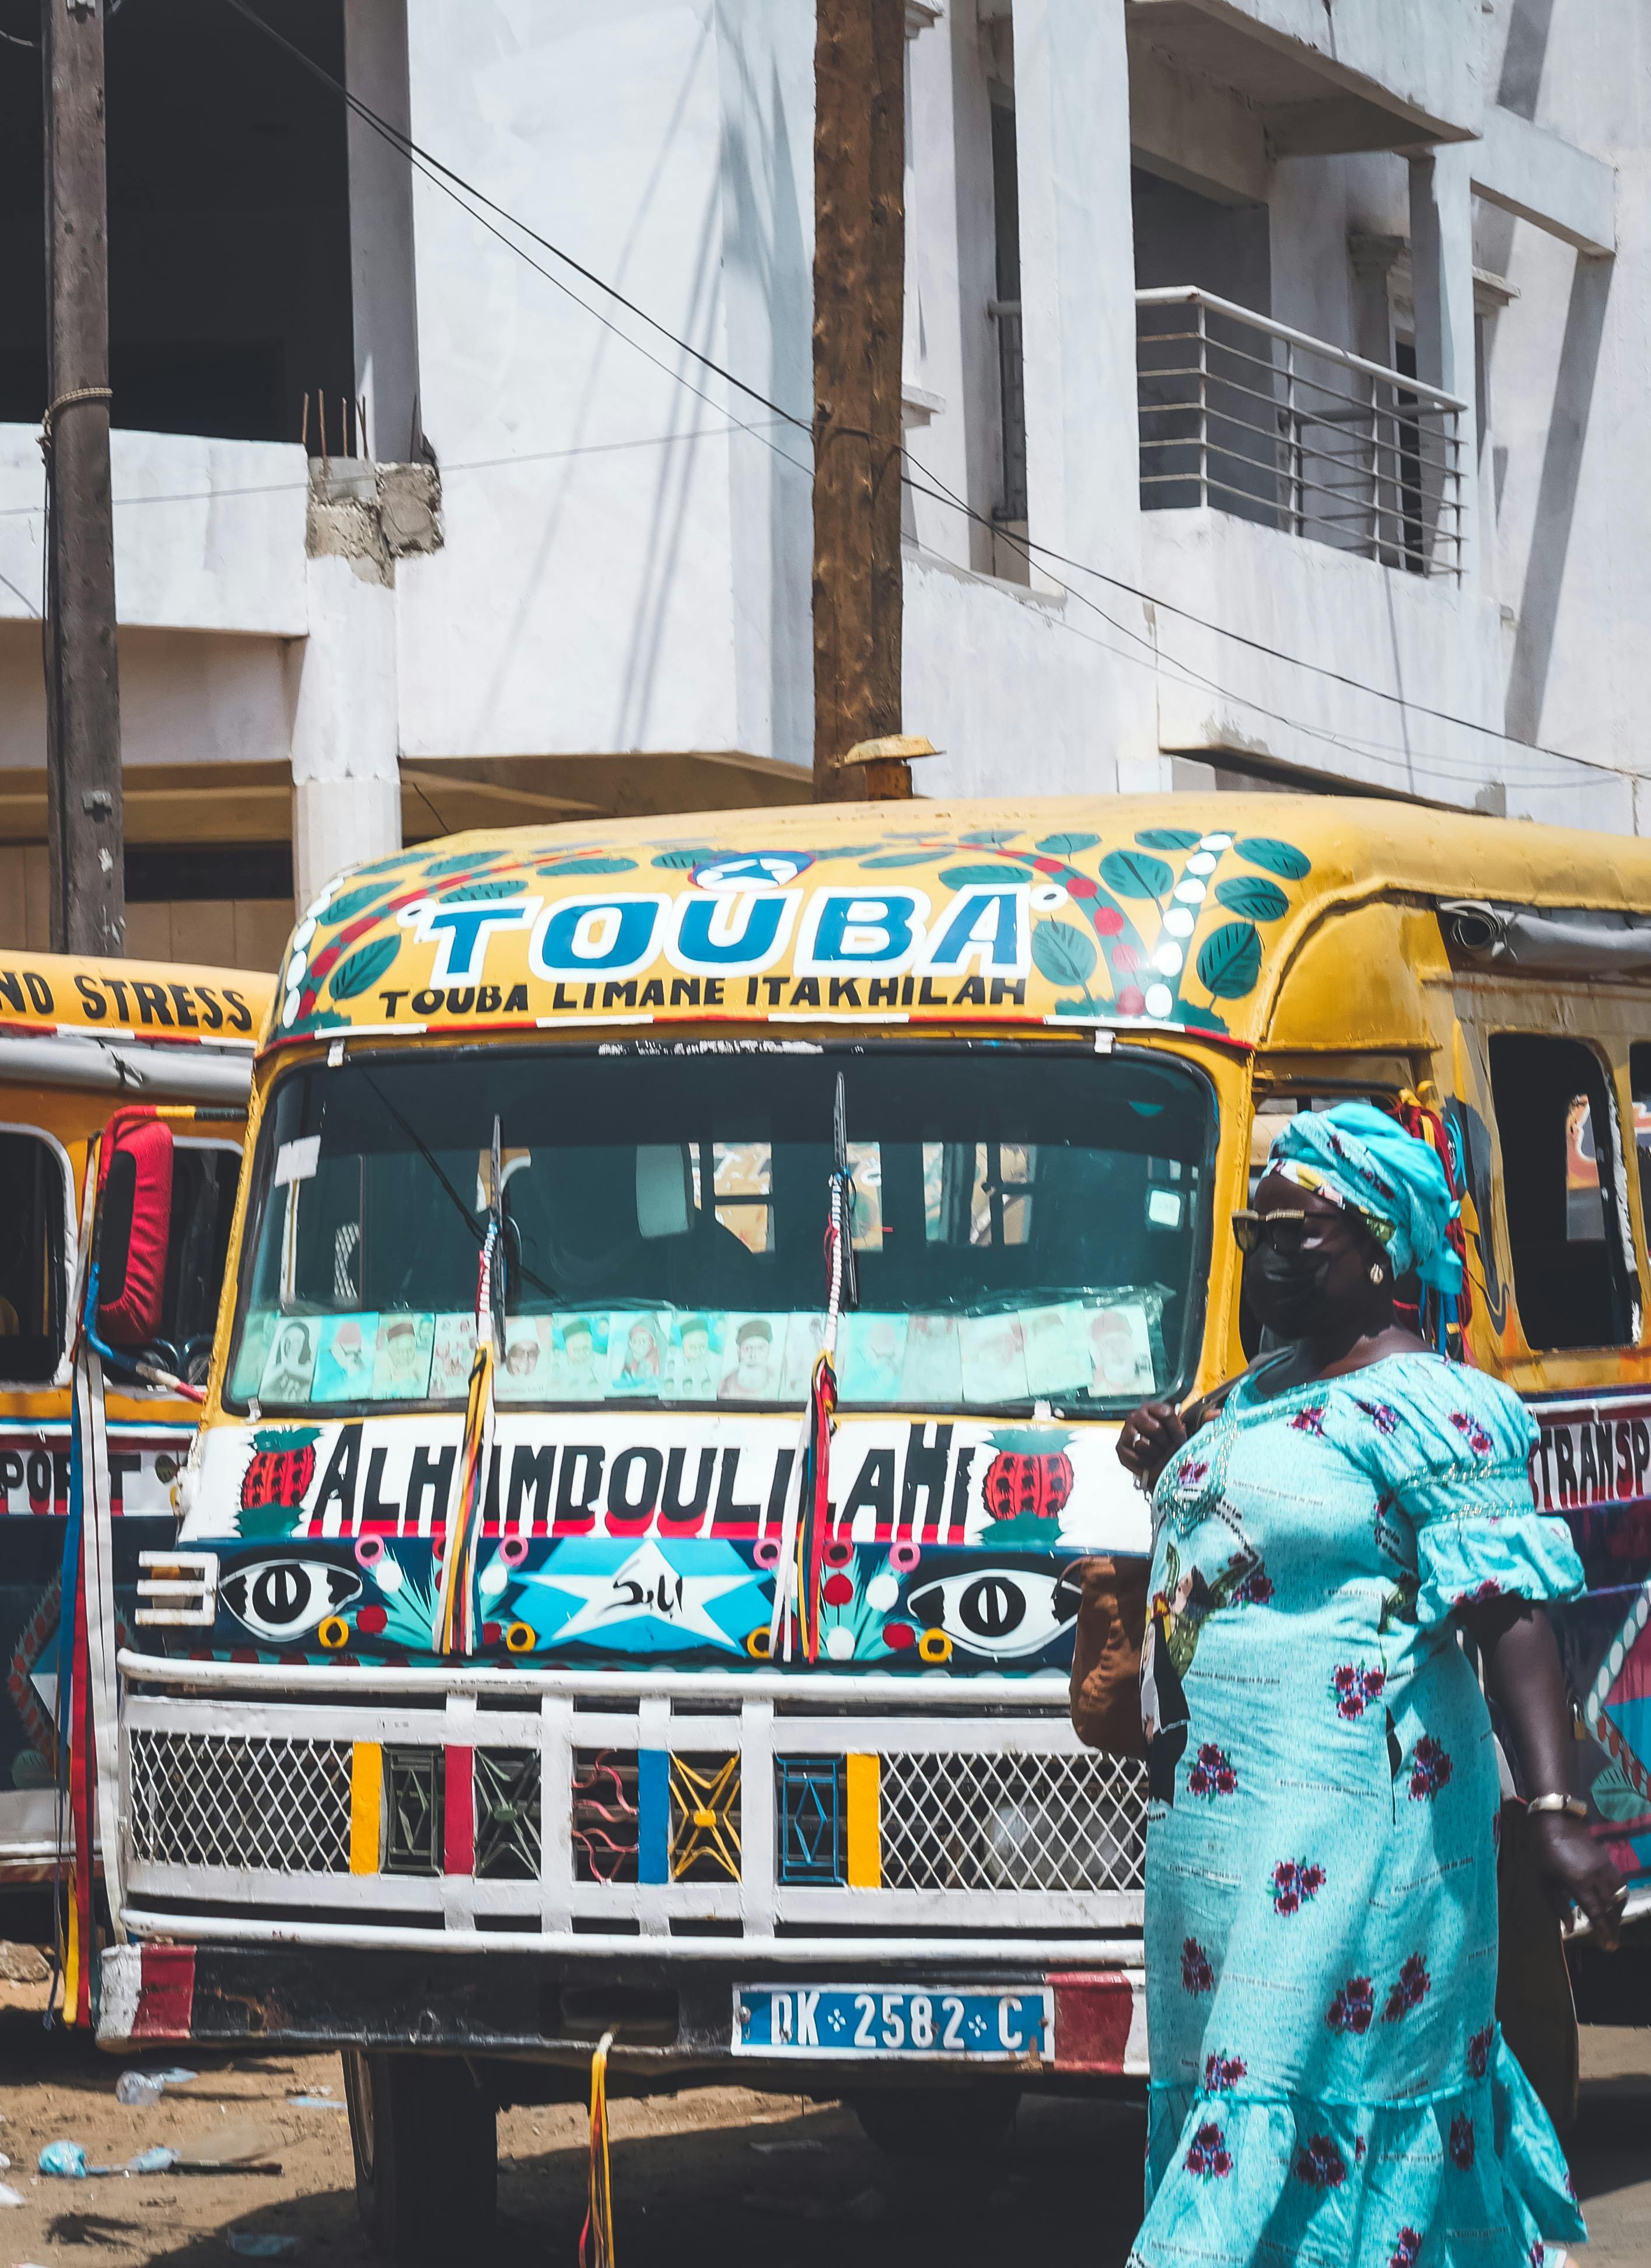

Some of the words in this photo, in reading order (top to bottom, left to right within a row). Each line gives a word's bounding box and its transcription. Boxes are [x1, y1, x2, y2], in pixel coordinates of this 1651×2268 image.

[429, 883, 1032, 989] TOUBA
[74, 975, 252, 1031] STRESS
[379, 984, 528, 1018] TOUBA
[552, 978, 725, 1010] LIMANE
[746, 977, 1027, 1006] ITAKHILAH
[771, 1990, 820, 2046] DK
[854, 1993, 965, 2049] 2582
[998, 1994, 1023, 2049] C
